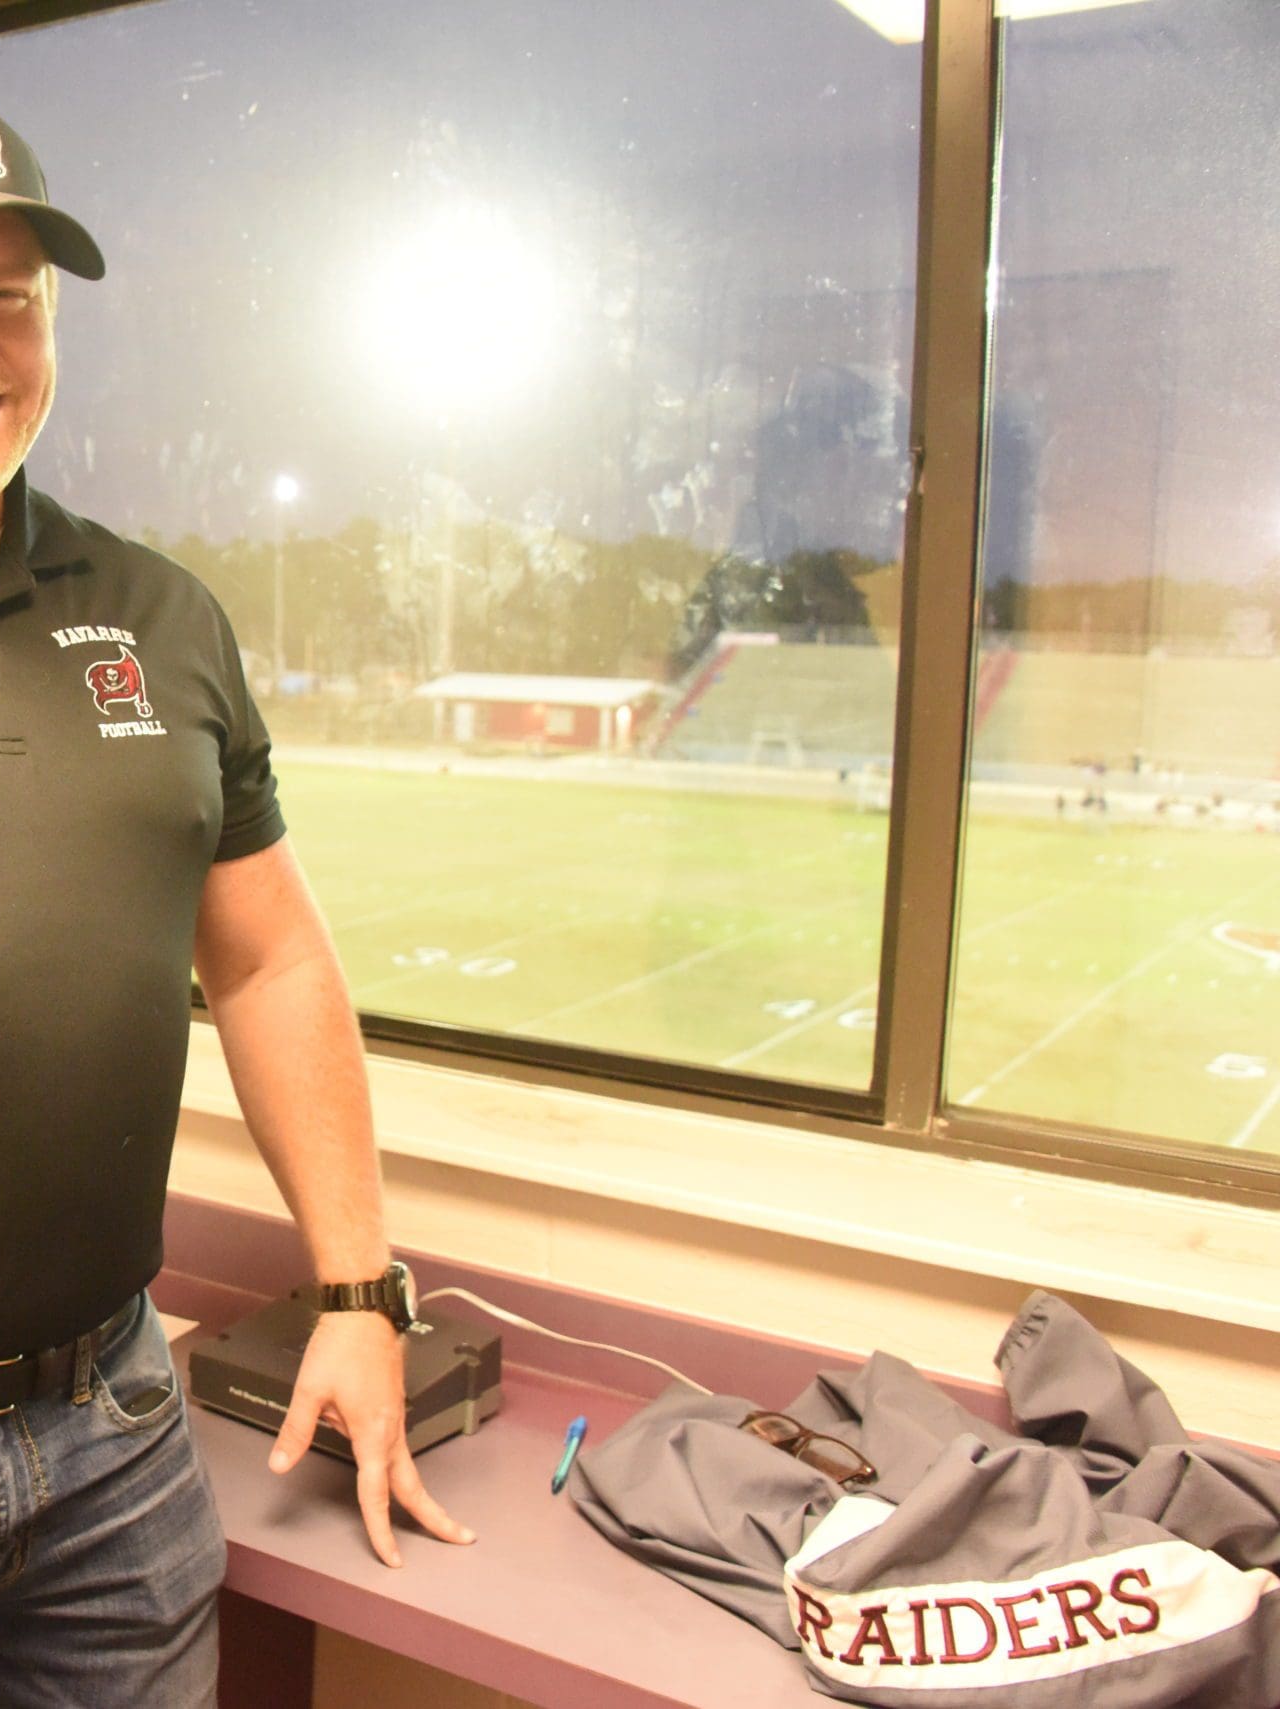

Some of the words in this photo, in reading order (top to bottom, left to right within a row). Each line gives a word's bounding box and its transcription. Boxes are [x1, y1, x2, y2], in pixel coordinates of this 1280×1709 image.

[51, 625, 136, 648] NAVARRE
[98, 720, 168, 739] FOOTBALL
[791, 1567, 1163, 1667] RAIDERS
